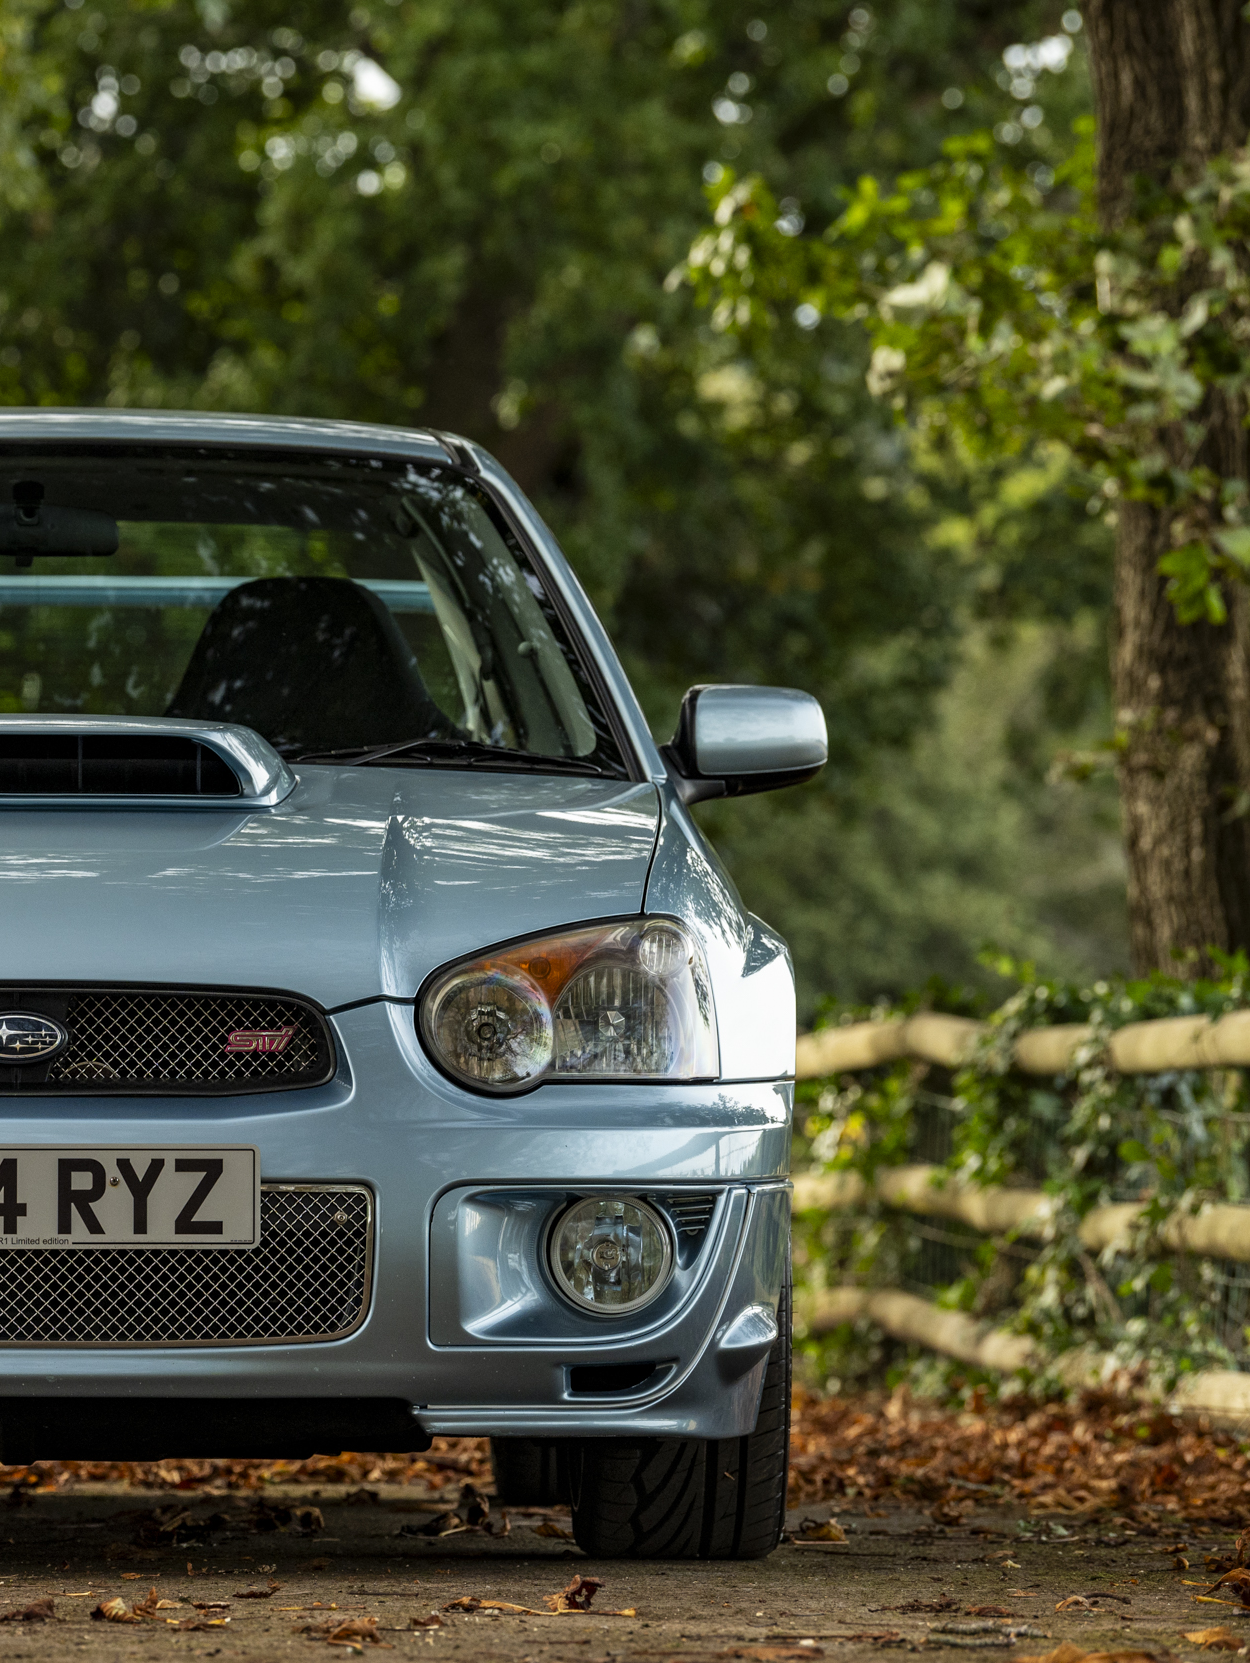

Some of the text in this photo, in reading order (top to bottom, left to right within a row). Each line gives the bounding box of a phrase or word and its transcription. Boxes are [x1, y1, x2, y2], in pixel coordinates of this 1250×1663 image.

[57, 1157, 224, 1235] RYZ
[11, 1236, 41, 1245] Limited
[42, 1236, 70, 1245] edition
